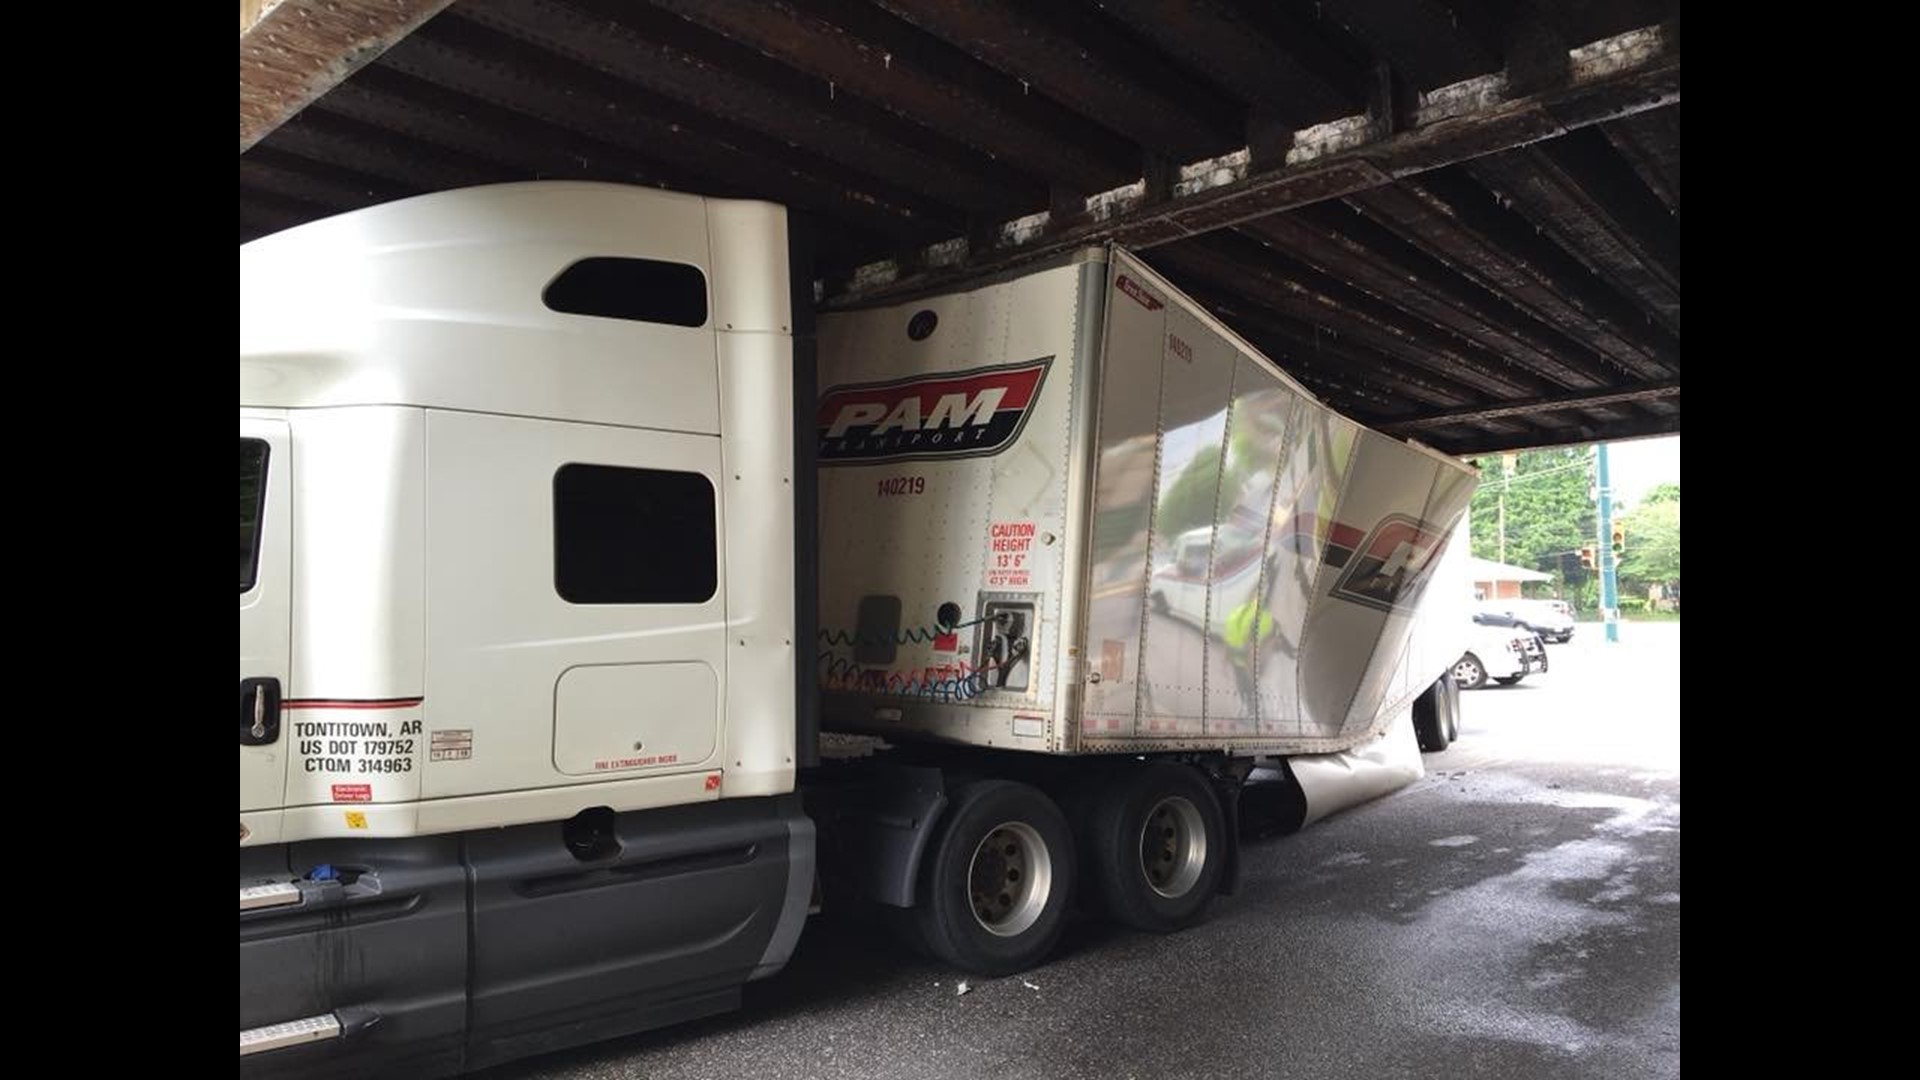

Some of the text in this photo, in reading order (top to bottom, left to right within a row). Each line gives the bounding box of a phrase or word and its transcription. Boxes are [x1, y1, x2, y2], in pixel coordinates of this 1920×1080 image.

[825, 387, 1008, 438] PAM
[815, 428, 986, 451] TRANSPORT
[877, 476, 925, 497] 140219
[991, 523, 1036, 537] CAUTION
[992, 538, 1032, 552] HEIGHT
[294, 720, 422, 738] TONTITOWN, AR
[300, 740, 322, 755] US
[329, 740, 358, 755] DOT
[364, 739, 414, 755] 179752
[358, 757, 413, 773] 314963
